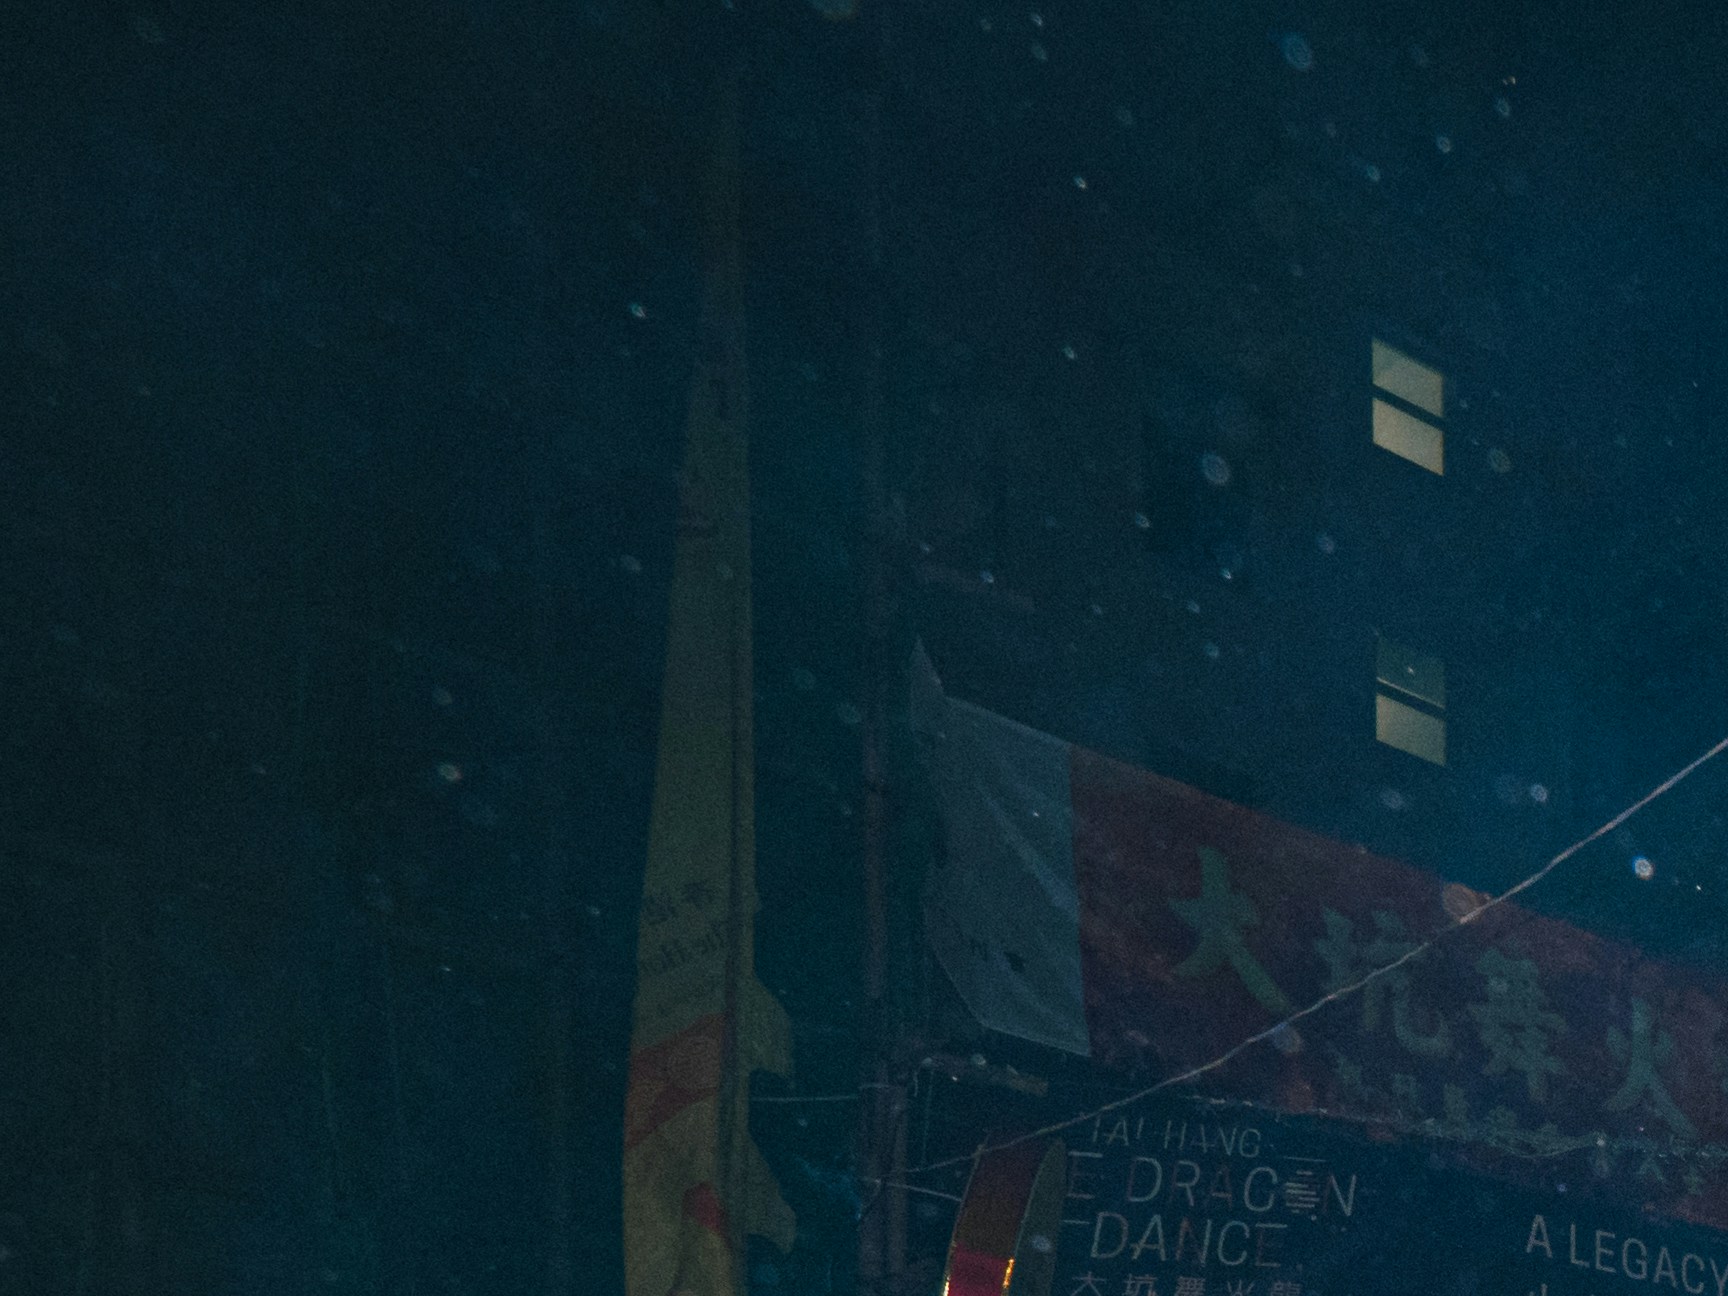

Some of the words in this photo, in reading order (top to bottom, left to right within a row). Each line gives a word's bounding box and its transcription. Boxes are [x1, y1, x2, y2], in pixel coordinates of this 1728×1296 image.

[1092, 1115, 1144, 1147] TAI
[1164, 1119, 1262, 1159] HANG
[1090, 1211, 1289, 1269] DANCE
[1526, 1213, 1554, 1259] A
